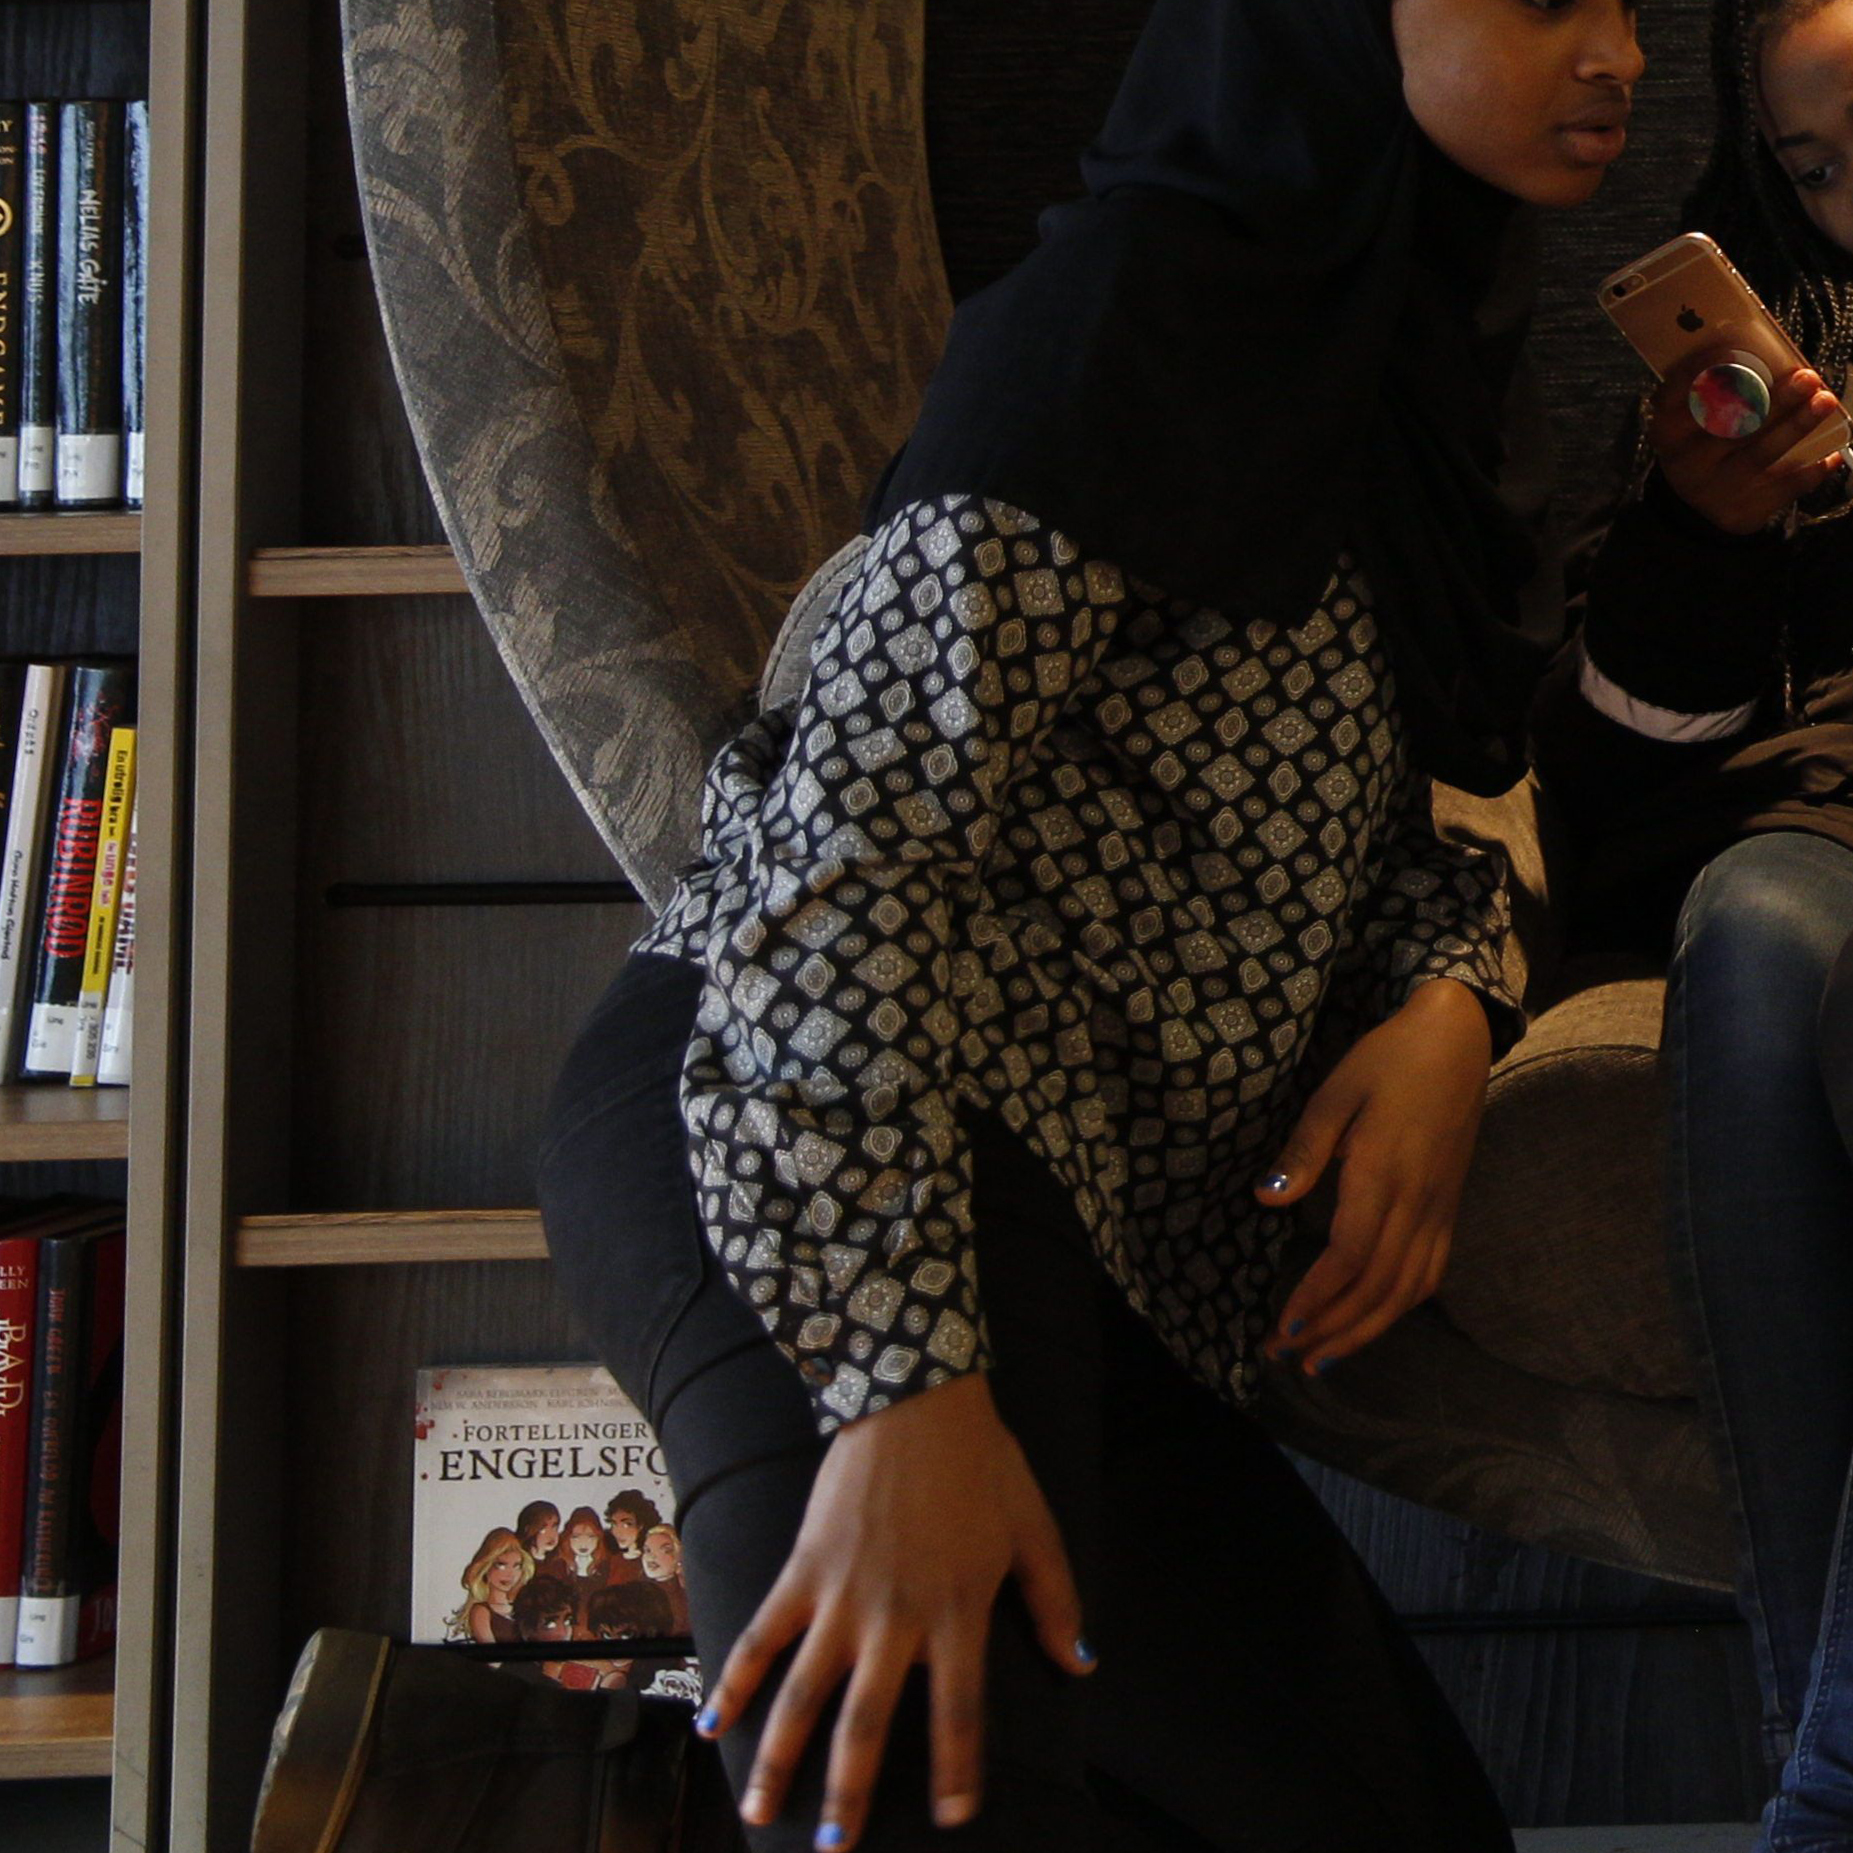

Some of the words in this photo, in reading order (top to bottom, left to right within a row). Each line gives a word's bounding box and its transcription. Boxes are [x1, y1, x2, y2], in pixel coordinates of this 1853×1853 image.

[78, 189, 102, 251] NELIAS
[76, 259, 109, 305] GÅTE
[45, 797, 102, 958] RUBINRØD
[463, 1422, 648, 1442] FORTELLINGER
